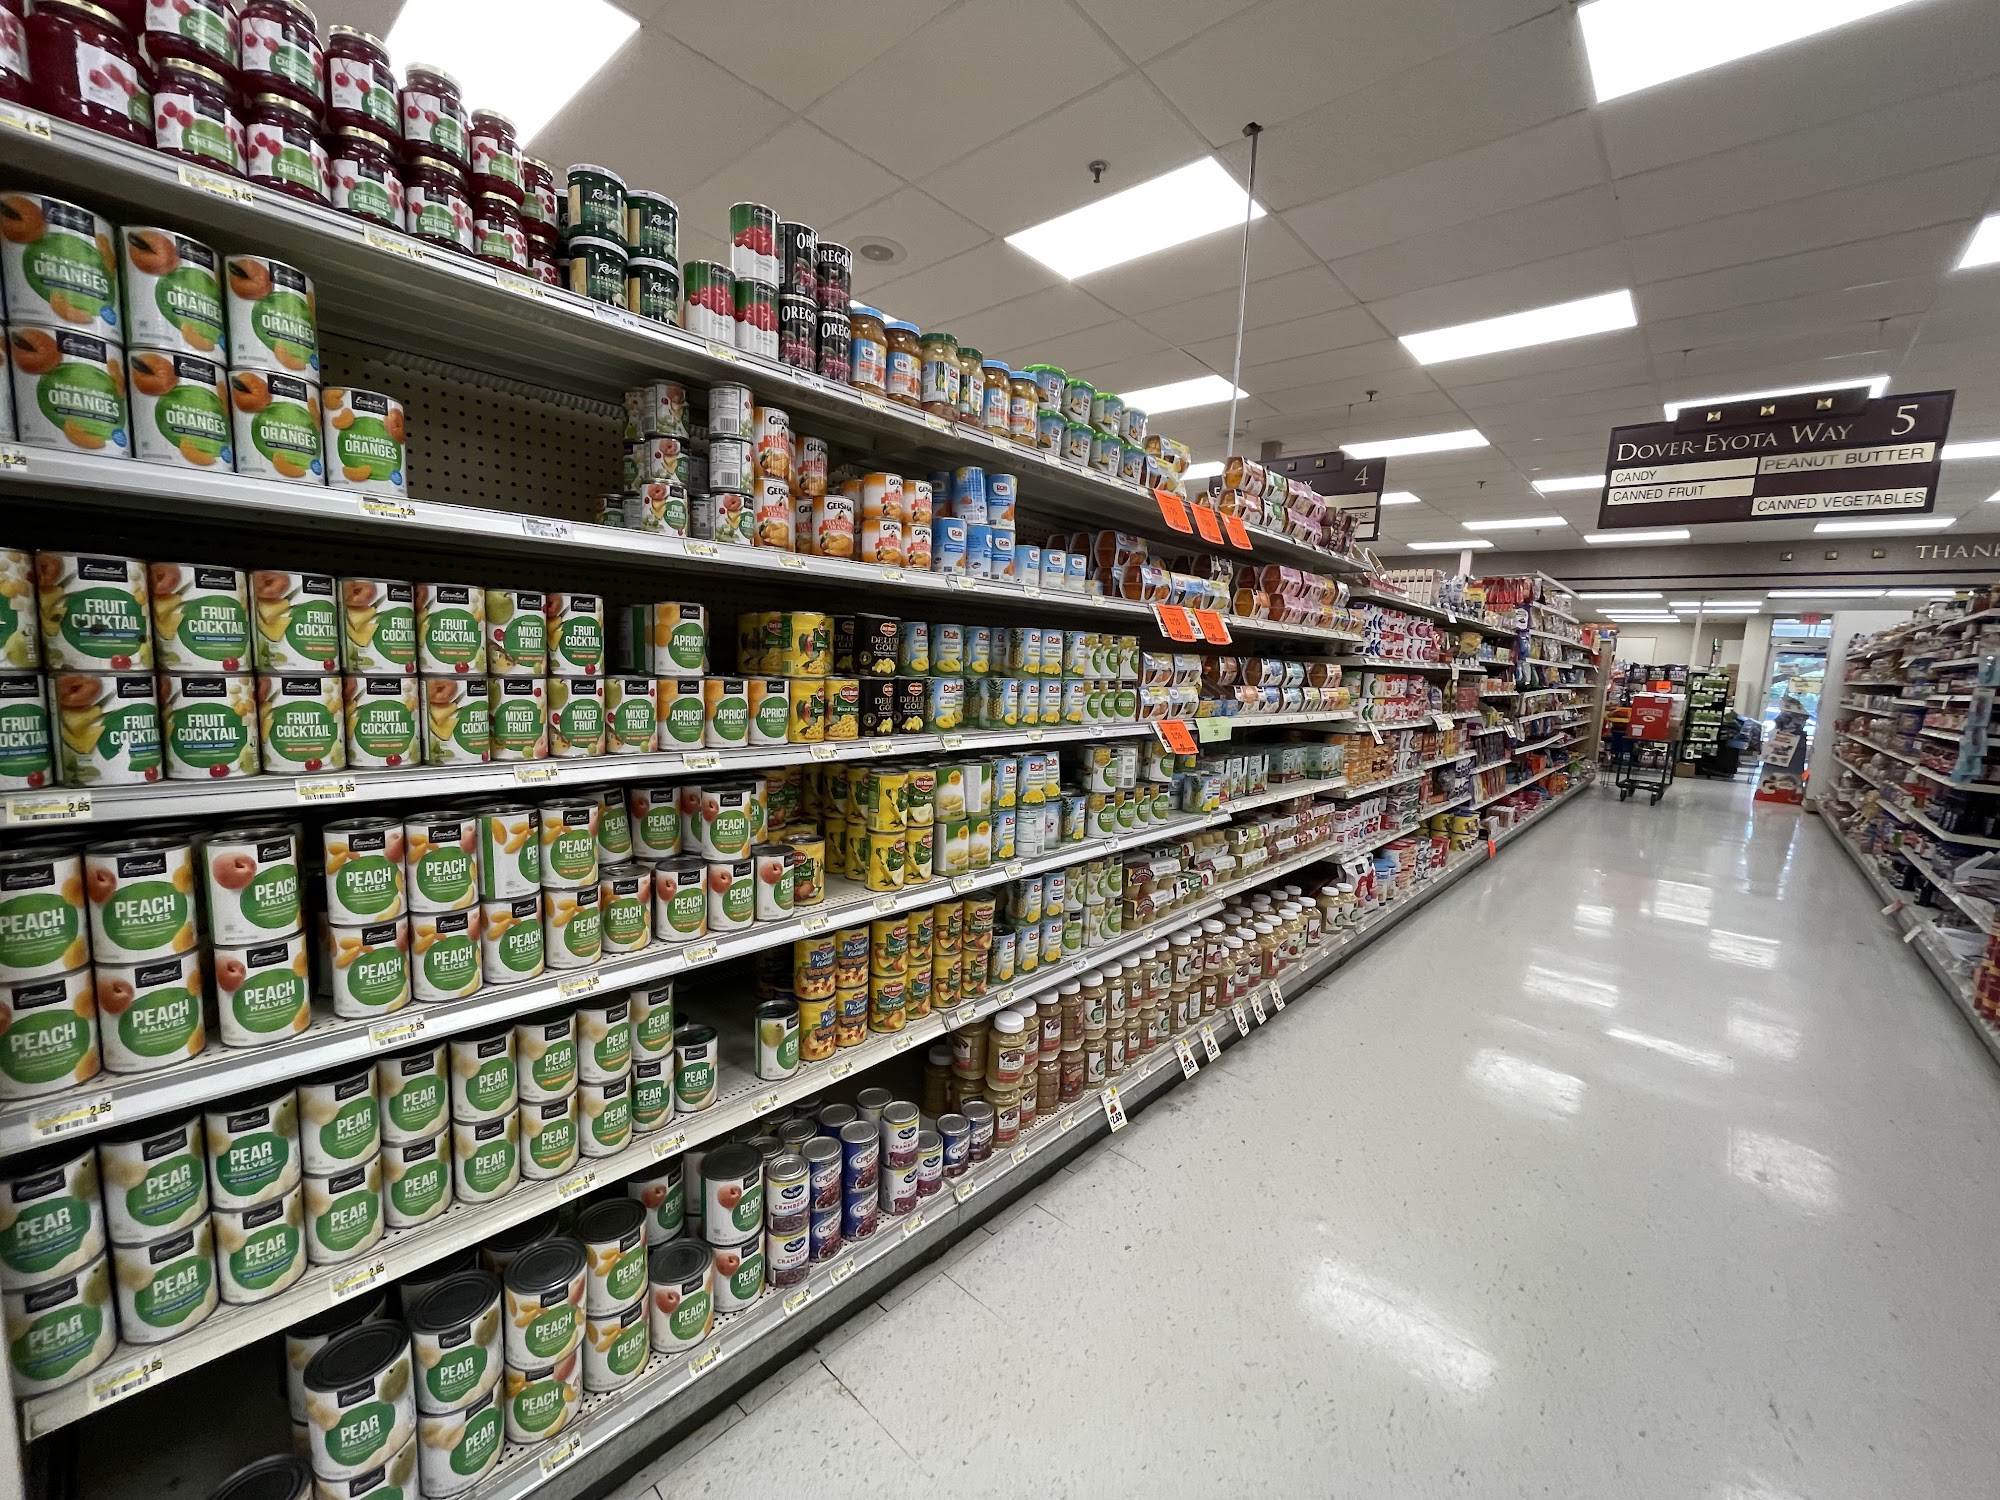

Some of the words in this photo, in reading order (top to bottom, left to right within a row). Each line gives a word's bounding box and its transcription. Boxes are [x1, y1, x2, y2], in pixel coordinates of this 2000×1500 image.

[232, 189, 252, 202] 3.45
[420, 216, 455, 232] CHERRIES
[34, 260, 108, 295] ORANGES
[261, 314, 315, 341] ORANGES
[48, 389, 119, 418] ORANGES
[166, 409, 226, 436] ORANGES
[1890, 404, 1918, 436] 5
[260, 425, 316, 450] ORANGES
[349, 433, 393, 447] MANDARIN
[1616, 434, 1778, 461] DOVER-EYOTA
[1791, 423, 1853, 444] WAY
[344, 439, 397, 461] ORANGES
[1764, 455, 1839, 471] PEANUT
[1845, 447, 1924, 464] BUTTER
[1355, 466, 1368, 486] 4
[1615, 470, 1657, 482] CANDY
[1613, 489, 1663, 502] CANNED
[1668, 485, 1706, 497] FRUIT
[1757, 498, 1817, 512] CANNED
[1822, 492, 1924, 507] VEGETABLES
[84, 598, 128, 614] FRUIT
[200, 606, 236, 620] FRUIT
[307, 610, 333, 624] FRUIT
[440, 618, 468, 630] FRUIT
[188, 620, 246, 635] COCKTAIL
[518, 626, 542, 638] MIXED
[573, 626, 596, 636] FRUIT
[431, 630, 476, 644] COCKTAIL
[520, 637, 541, 649] FRUIT
[565, 636, 600, 648] COCKTAIL
[188, 714, 226, 728] FRUIT
[286, 711, 320, 725] FRUIT
[370, 710, 400, 722] FRUIT
[505, 710, 534, 722] MIXED
[572, 709, 598, 720] MIXED
[625, 709, 649, 720] MIXED
[671, 709, 703, 722] APRICOT
[717, 708, 747, 720] APRICOT
[761, 707, 788, 719] APRICOT
[2, 715, 40, 732] FRUIT
[276, 724, 331, 738] COCKTAIL
[361, 722, 410, 734] COCKTAIL
[507, 722, 532, 733] FRUIT
[574, 720, 596, 731] FRUIT
[627, 719, 648, 730] FRUIT
[177, 727, 240, 742] COCKTAIL
[1031, 763, 1043, 771] Dole
[339, 784, 354, 793] 2.65
[68, 801, 90, 812] 2.65
[647, 814, 675, 826] PEACH
[717, 818, 744, 830] PEACH
[559, 838, 592, 853] PEACH
[426, 858, 466, 876] PEACH
[346, 867, 392, 886] PEACH
[432, 873, 463, 882] SLICES
[254, 877, 296, 901] PEACH
[354, 883, 386, 892] SLICES
[115, 894, 175, 918] PEACH
[674, 894, 703, 909] PEACH
[122, 912, 171, 926] HALVES
[610, 905, 642, 920] PEACH
[615, 917, 639, 926] SLICES
[5, 928, 60, 942] HALVES
[509, 928, 541, 948] PEACH
[433, 946, 473, 966] PEACH
[358, 957, 401, 980] PEACH
[440, 960, 469, 972] SLICES
[366, 973, 398, 986] SLICES
[588, 977, 599, 986] 2.65
[244, 979, 295, 1005] PEACH
[250, 996, 292, 1012] HALVES
[132, 999, 190, 1028] PEACH
[648, 1012, 669, 1029] PEAR
[139, 1017, 186, 1034] HALVES
[410, 1021, 424, 1031] 2.65
[10, 1022, 77, 1053] PEACH
[606, 1029, 628, 1048] PEAR
[545, 1048, 571, 1068] PEAR
[479, 1067, 508, 1088] PEAR
[685, 1069, 708, 1083] PEAR
[403, 1084, 436, 1107] PEAR
[637, 1087, 661, 1100] PEAR
[90, 1102, 111, 1116] 2.65
[604, 1104, 627, 1124] PEAR
[337, 1107, 372, 1134] PEAR
[541, 1126, 569, 1144] PEAR
[230, 1141, 272, 1166] PEAR
[475, 1150, 505, 1171] PEAR
[230, 1157, 273, 1173] HALVES
[146, 1164, 192, 1195] PEAR
[404, 1170, 438, 1194] PEAR
[330, 1201, 367, 1227] PEAR
[16, 1207, 72, 1239] PEAR
[245, 1232, 286, 1260] PEAR
[369, 1264, 384, 1277] 2.65
[616, 1260, 644, 1282] PEACH
[738, 1261, 762, 1284] PEACH
[152, 1264, 198, 1297] PEAR
[678, 1298, 707, 1322] PEACH
[28, 1313, 83, 1348] PEAR
[535, 1314, 572, 1338] PEACH
[617, 1330, 645, 1358] PEACH
[440, 1356, 474, 1379] PEAR
[522, 1388, 559, 1411] PEACH
[340, 1414, 380, 1441] PEAR
[466, 1420, 495, 1452] PEAR
